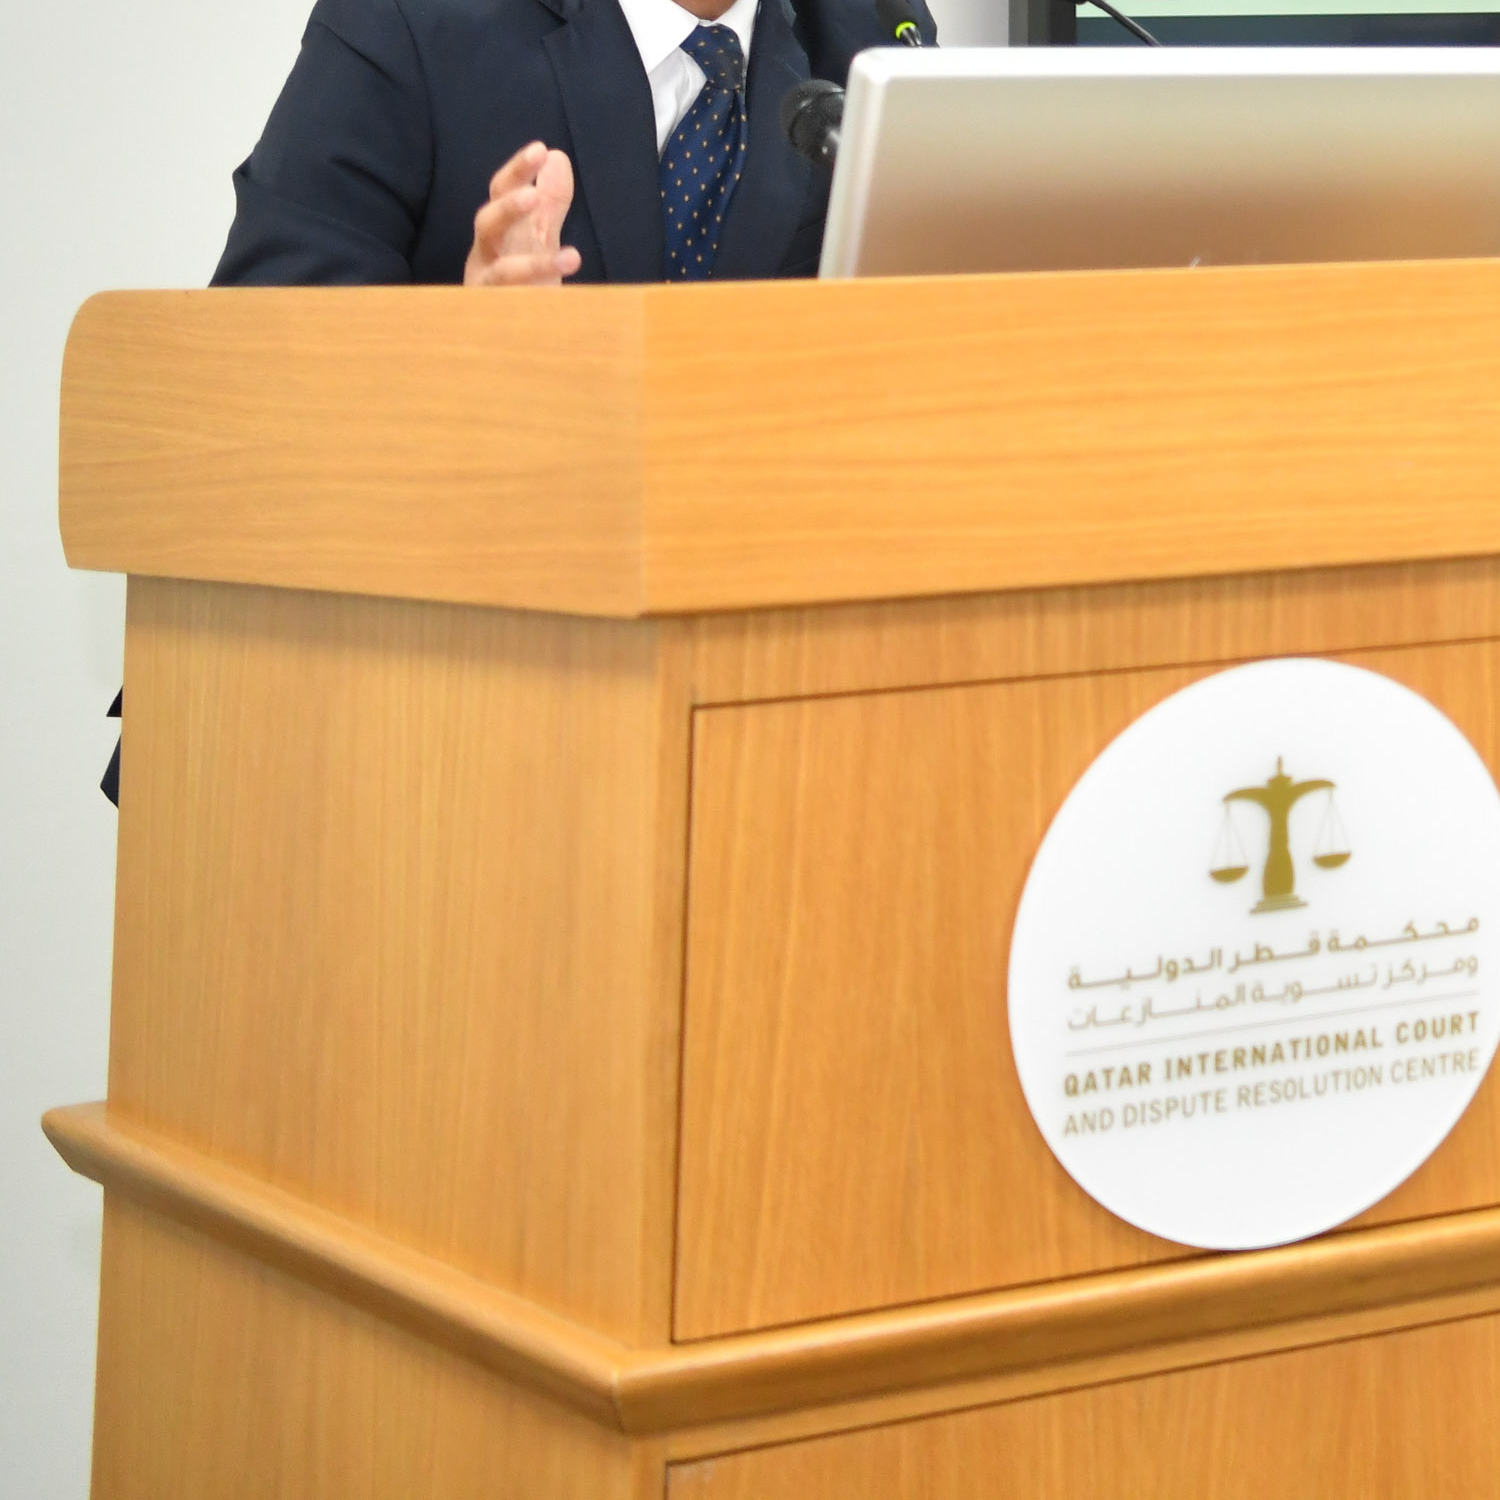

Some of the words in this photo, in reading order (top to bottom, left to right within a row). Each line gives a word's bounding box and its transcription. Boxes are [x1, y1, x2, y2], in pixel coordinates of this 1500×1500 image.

[1232, 930, 1321, 973] قطر
[1327, 916, 1480, 951] محكمة
[1067, 947, 1224, 990] الدولية
[1250, 966, 1379, 1004] تسوية
[1384, 955, 1479, 991] ومركز
[1067, 982, 1245, 1031] المنازعات
[1064, 1062, 1153, 1098] QATAR
[1165, 1027, 1384, 1081] INTERNATIONAL
[1396, 1011, 1480, 1045] COURT
[1062, 1105, 1114, 1138] AND
[1123, 1090, 1229, 1128] DISPUTE
[1237, 1064, 1383, 1107] RESOLUTION
[1390, 1047, 1480, 1085] CENTRE
